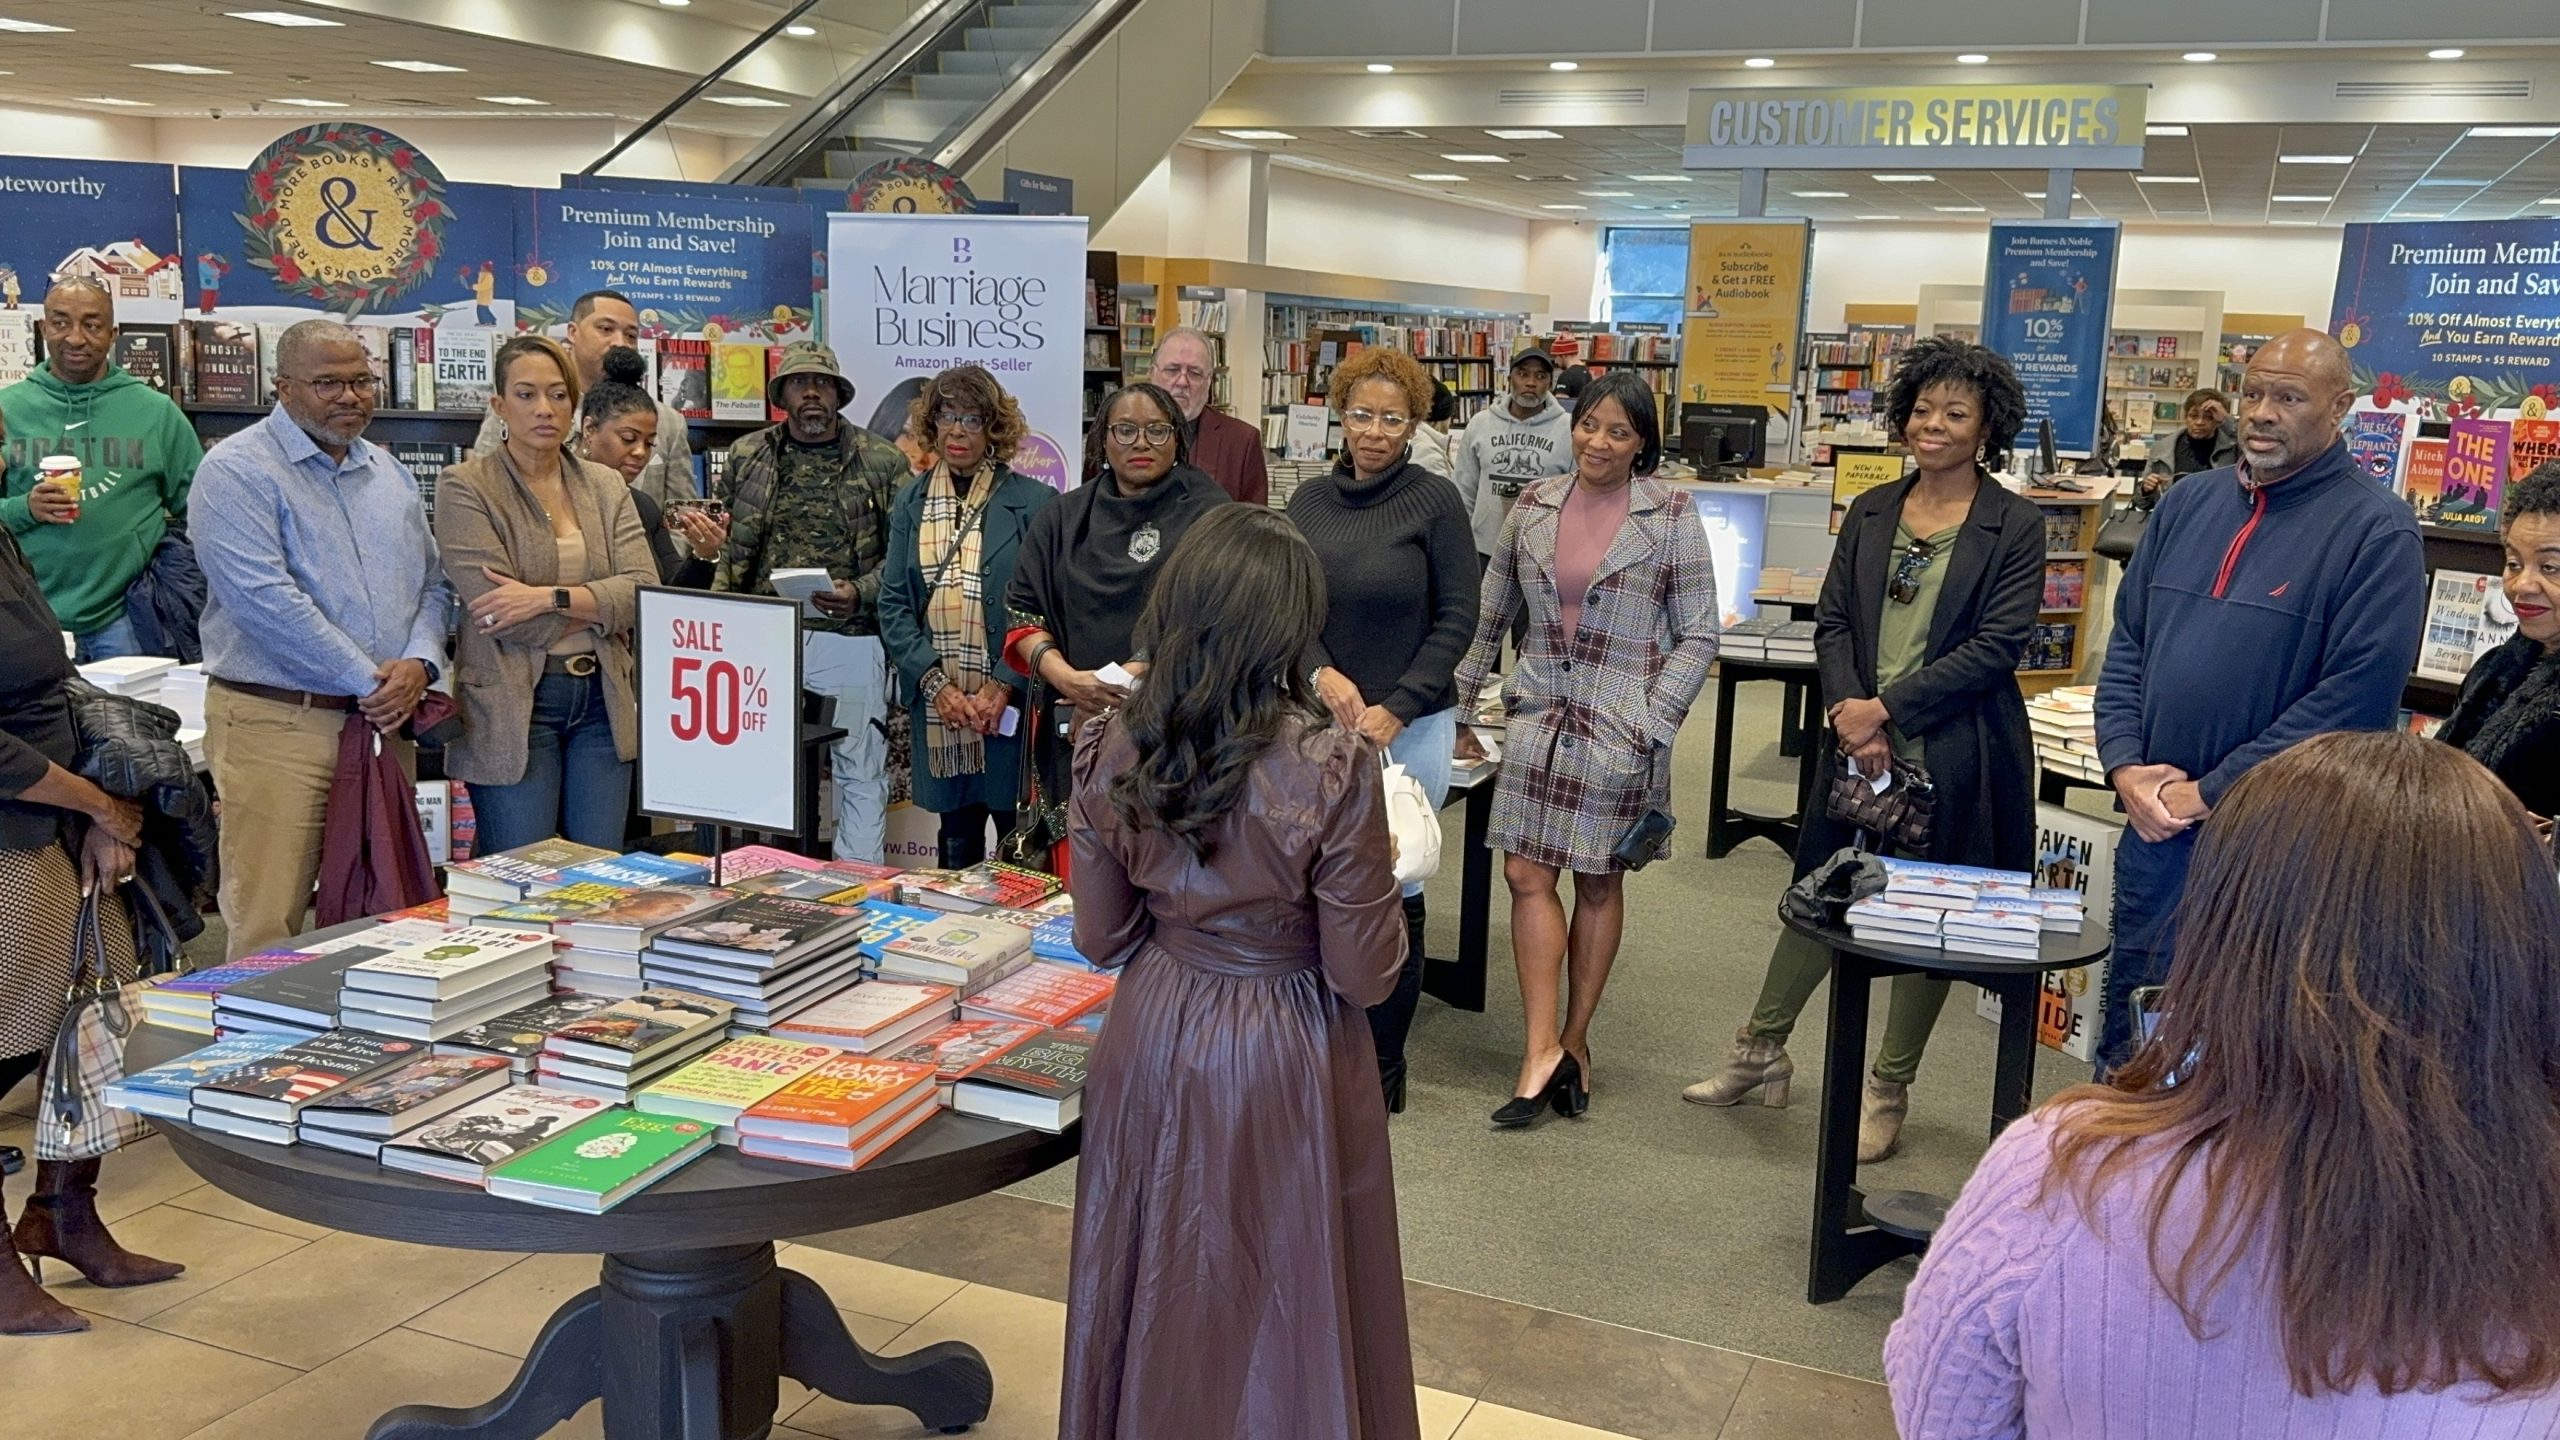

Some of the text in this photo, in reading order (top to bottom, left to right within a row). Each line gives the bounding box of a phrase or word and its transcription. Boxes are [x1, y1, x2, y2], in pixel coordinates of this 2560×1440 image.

[1709, 97, 2119, 146] CUSTOMER SERVICES
[0, 176, 106, 200] teworthy
[280, 153, 371, 260] READ MORE BOOKS
[560, 205, 776, 239] Premium Membership
[603, 230, 736, 254] Join and Save!
[2010, 236, 2028, 246] Join
[2030, 237, 2058, 246] Barnes
[2068, 238, 2093, 246] Noble
[2004, 248, 2098, 258] Premium Membership
[2389, 243, 2486, 265] Premium
[590, 260, 748, 280] 10% Off Almost Everything
[1720, 261, 1769, 273] Subscribe
[2030, 259, 2070, 268] and Save!
[628, 274, 650, 286] You
[653, 276, 680, 287] Earn
[683, 276, 732, 290] Rewards
[1712, 276, 1720, 285] &
[1722, 276, 1740, 285] Get
[1750, 276, 1776, 286] FREE
[2426, 272, 2470, 298] Join
[2476, 272, 2519, 295] and
[874, 264, 1046, 322] Marriage
[1716, 288, 1770, 299] Audiobook
[2407, 312, 2434, 326] 10%
[2438, 312, 2462, 327] Off
[2464, 313, 2511, 328] Almost
[876, 307, 1044, 350] Business
[2420, 328, 2442, 342] And
[2446, 330, 2469, 344] You
[2474, 332, 2504, 345] Earn
[204, 344, 245, 356] GHOSTS
[438, 348, 486, 358] TO THE END
[666, 340, 712, 354] WOMAN
[894, 355, 949, 369] Amazon
[2013, 353, 2068, 363] YOU EARN
[2432, 353, 2443, 362] 10
[2445, 354, 2482, 364] STAMPS
[2507, 356, 2550, 366] REWARD
[129, 368, 152, 376] ORLD
[439, 364, 486, 380] EARTH
[2025, 364, 2078, 372] REWARDS
[716, 400, 760, 409] The Fabulist
[2358, 422, 2392, 434] THE SEA
[1490, 432, 1554, 454] CALIFORNIA
[2350, 439, 2398, 453] ELEPHANTS
[2456, 432, 2496, 462] THE
[10, 437, 145, 470] BOSTON
[400, 452, 444, 462] UNCERTAIN
[2415, 449, 2444, 462] Mitch
[406, 464, 442, 475] ROUND
[1852, 464, 1884, 472] NEW IN
[2410, 463, 2444, 477] Albom
[2448, 456, 2496, 490] ONE
[1845, 472, 1891, 481] PAPERBACK
[2440, 512, 2487, 524] JULIA ARGY
[2438, 590, 2481, 605] The Blue
[2434, 605, 2479, 620] Window
[672, 618, 723, 652] SALE
[2430, 634, 2472, 649] Suzanne
[2434, 647, 2462, 661] Berne
[670, 656, 768, 746] 50% OFF
[426, 797, 442, 805] MAN
[2035, 860, 2088, 894] ARTH
[779, 906, 813, 915] LIFE
[320, 1032, 346, 1042] The
[328, 1042, 347, 1050] Be
[348, 1046, 382, 1057] Free
[722, 1046, 819, 1067] STATE OF
[1021, 1047, 1085, 1066] BIG
[296, 1056, 361, 1072] DeSantis
[825, 1060, 898, 1074] HAPP
[994, 1055, 1088, 1082] MYTH
[801, 1075, 894, 1091] HAPPY
[814, 1068, 916, 1086] MONEY
[782, 1084, 849, 1100] LIFE
[616, 1116, 671, 1134] Egg
